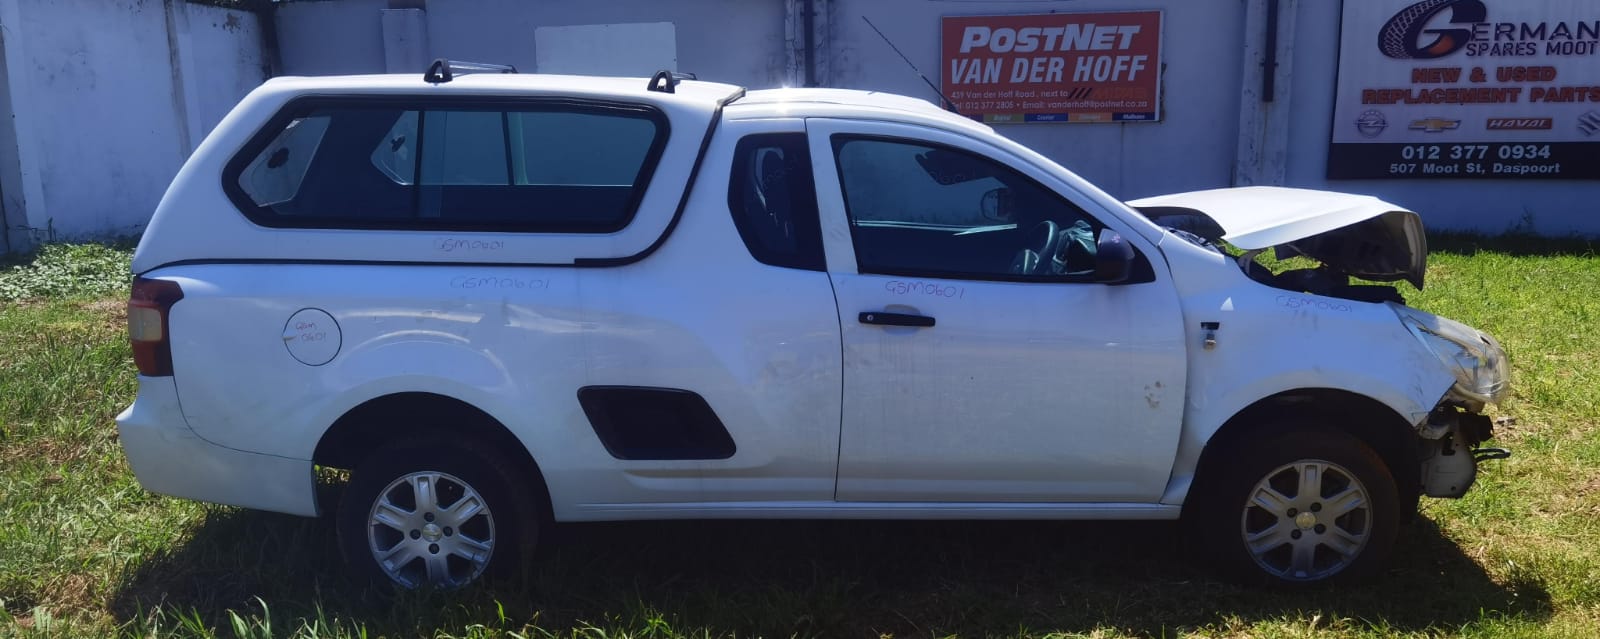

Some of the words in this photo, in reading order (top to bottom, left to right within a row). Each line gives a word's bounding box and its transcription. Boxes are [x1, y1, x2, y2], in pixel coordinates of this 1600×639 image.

[1466, 42, 1537, 57] SPARES
[1545, 40, 1599, 56] MOOT
[951, 58, 1003, 84] VAN
[1009, 56, 1065, 83] DER
[1072, 55, 1148, 82] HOFF
[1411, 67, 1462, 84] NEW
[1469, 66, 1487, 83] &
[1496, 66, 1557, 82] USED
[966, 90, 981, 99] Van
[984, 90, 996, 98] der
[1041, 89, 1058, 98] next
[1060, 89, 1069, 97] to
[1361, 87, 1522, 105] REPLACEMENT
[1530, 86, 1600, 103] PARTS
[981, 101, 995, 110] 377
[1489, 118, 1548, 129] HAVAL
[1402, 146, 1440, 160] 012
[1450, 145, 1488, 159] 377
[1498, 145, 1551, 159] 0934
[1390, 163, 1417, 174] 507
[1423, 162, 1459, 173] Moot
[1466, 162, 1486, 175] St,
[1493, 162, 1561, 176] Daspoort
